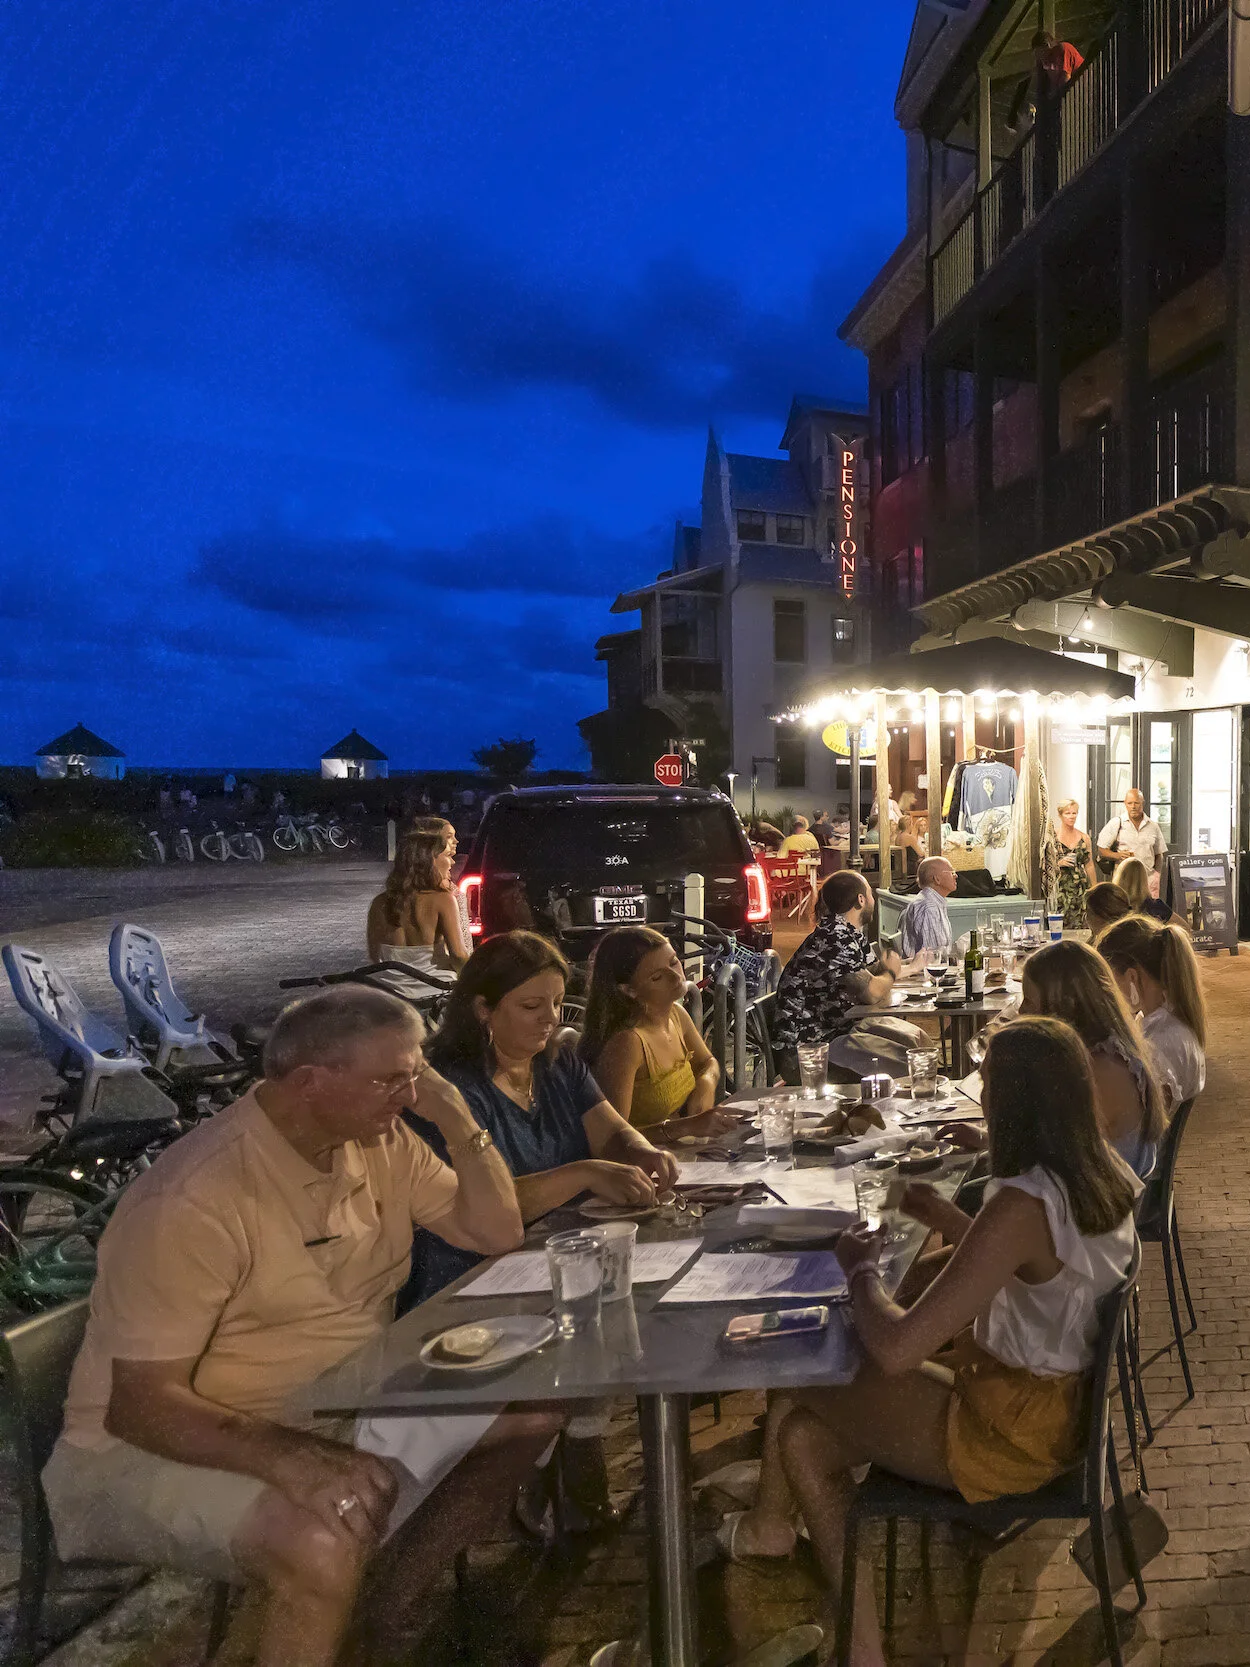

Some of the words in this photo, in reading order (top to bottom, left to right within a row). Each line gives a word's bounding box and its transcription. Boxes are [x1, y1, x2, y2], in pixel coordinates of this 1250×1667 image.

[840, 451, 857, 590] PENSIONE
[605, 855, 629, 867] 30A
[612, 905, 637, 917] SGSD
[1192, 934, 1213, 943] urate
